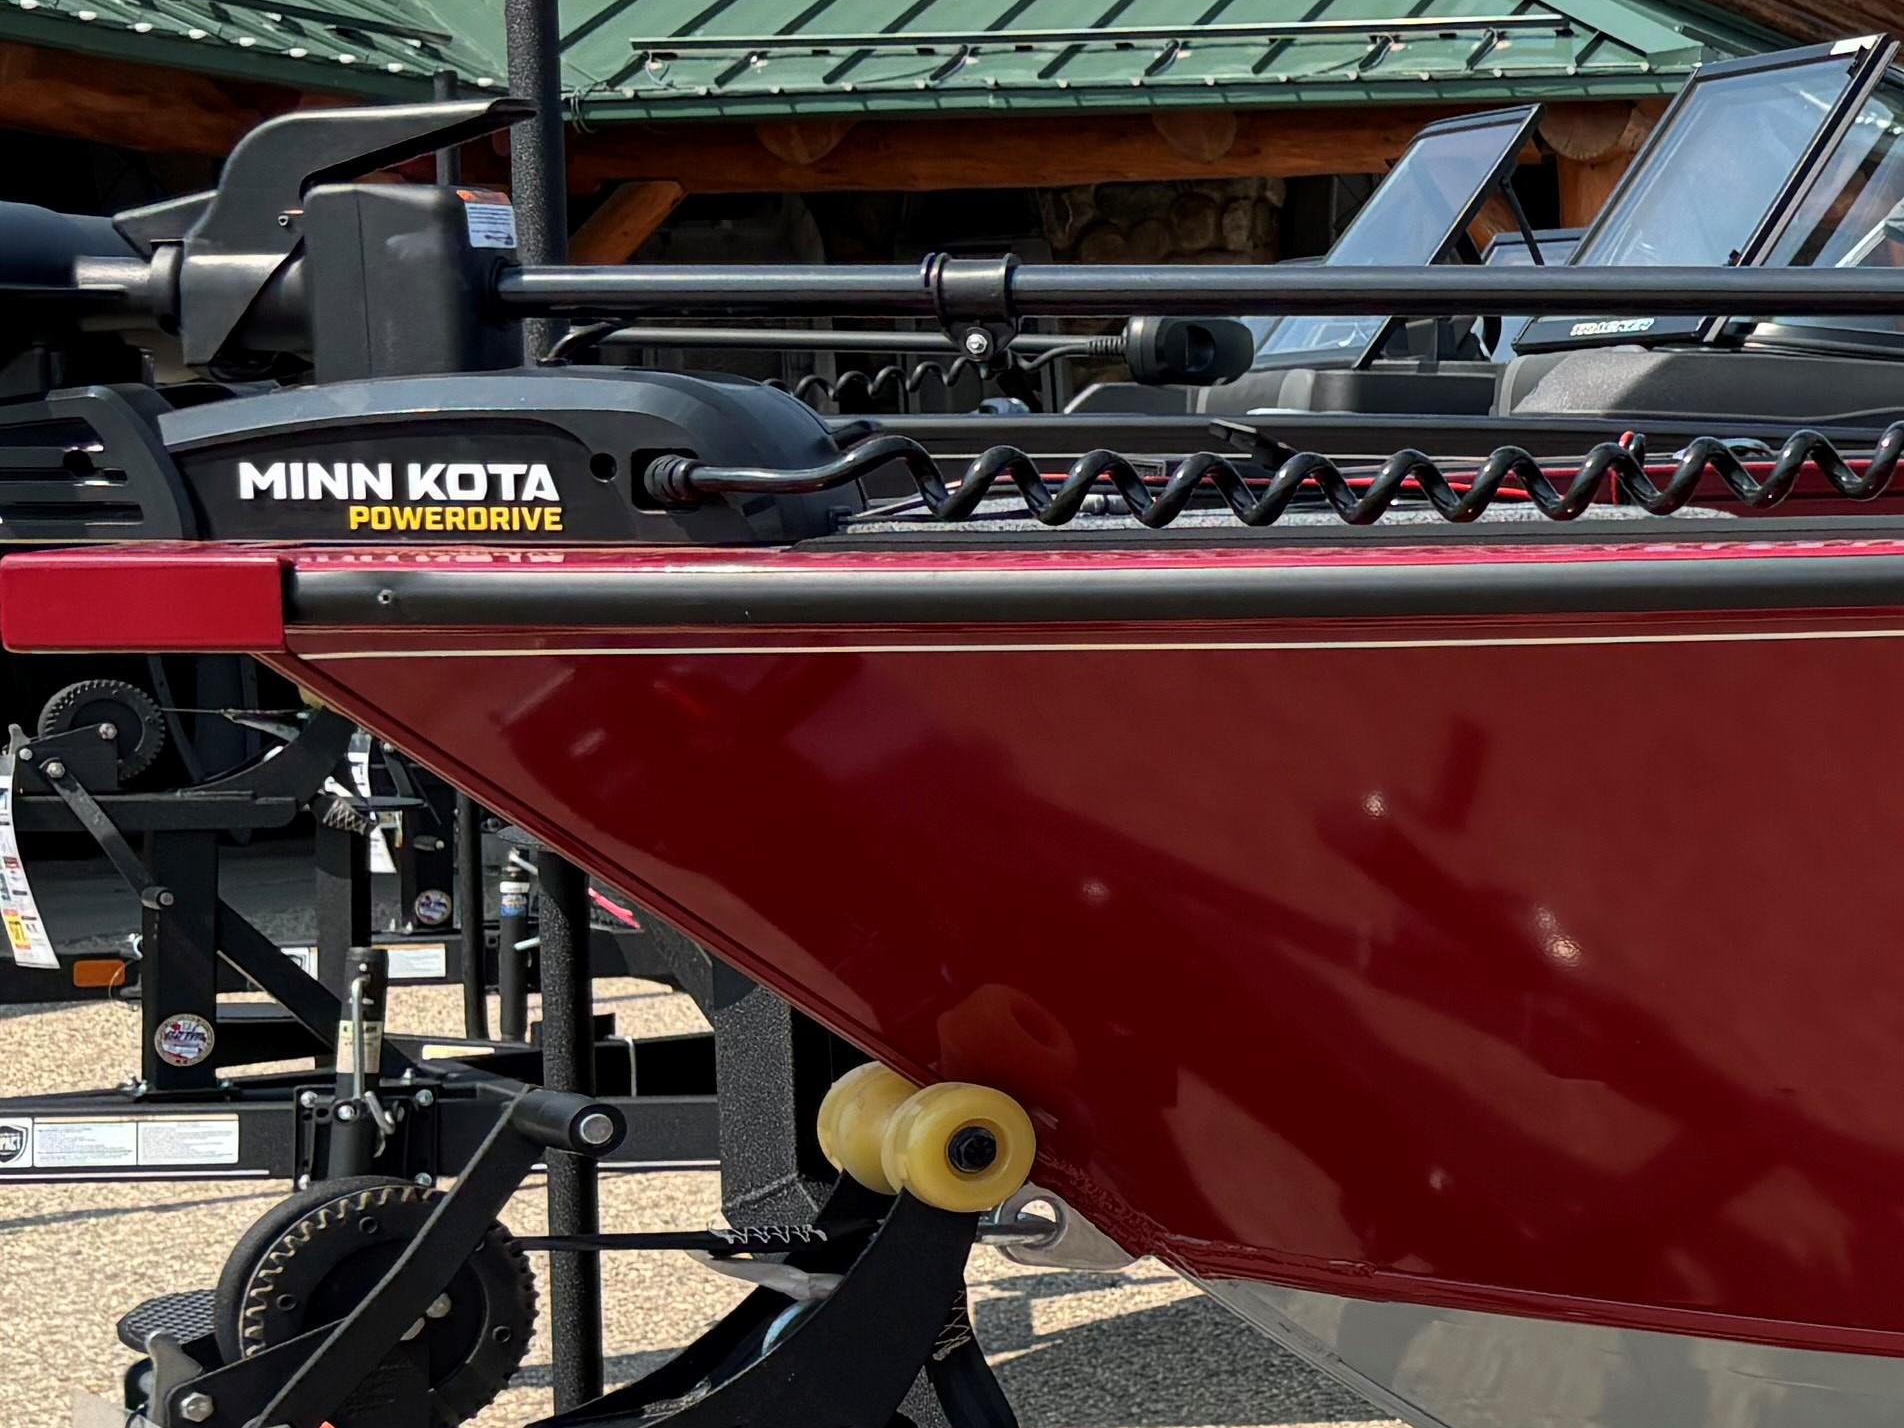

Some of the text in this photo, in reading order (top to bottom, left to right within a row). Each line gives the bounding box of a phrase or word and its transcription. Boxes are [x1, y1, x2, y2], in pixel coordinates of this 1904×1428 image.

[238, 461, 560, 502] MINN KOTA
[349, 505, 564, 532] POWERDRIVE
